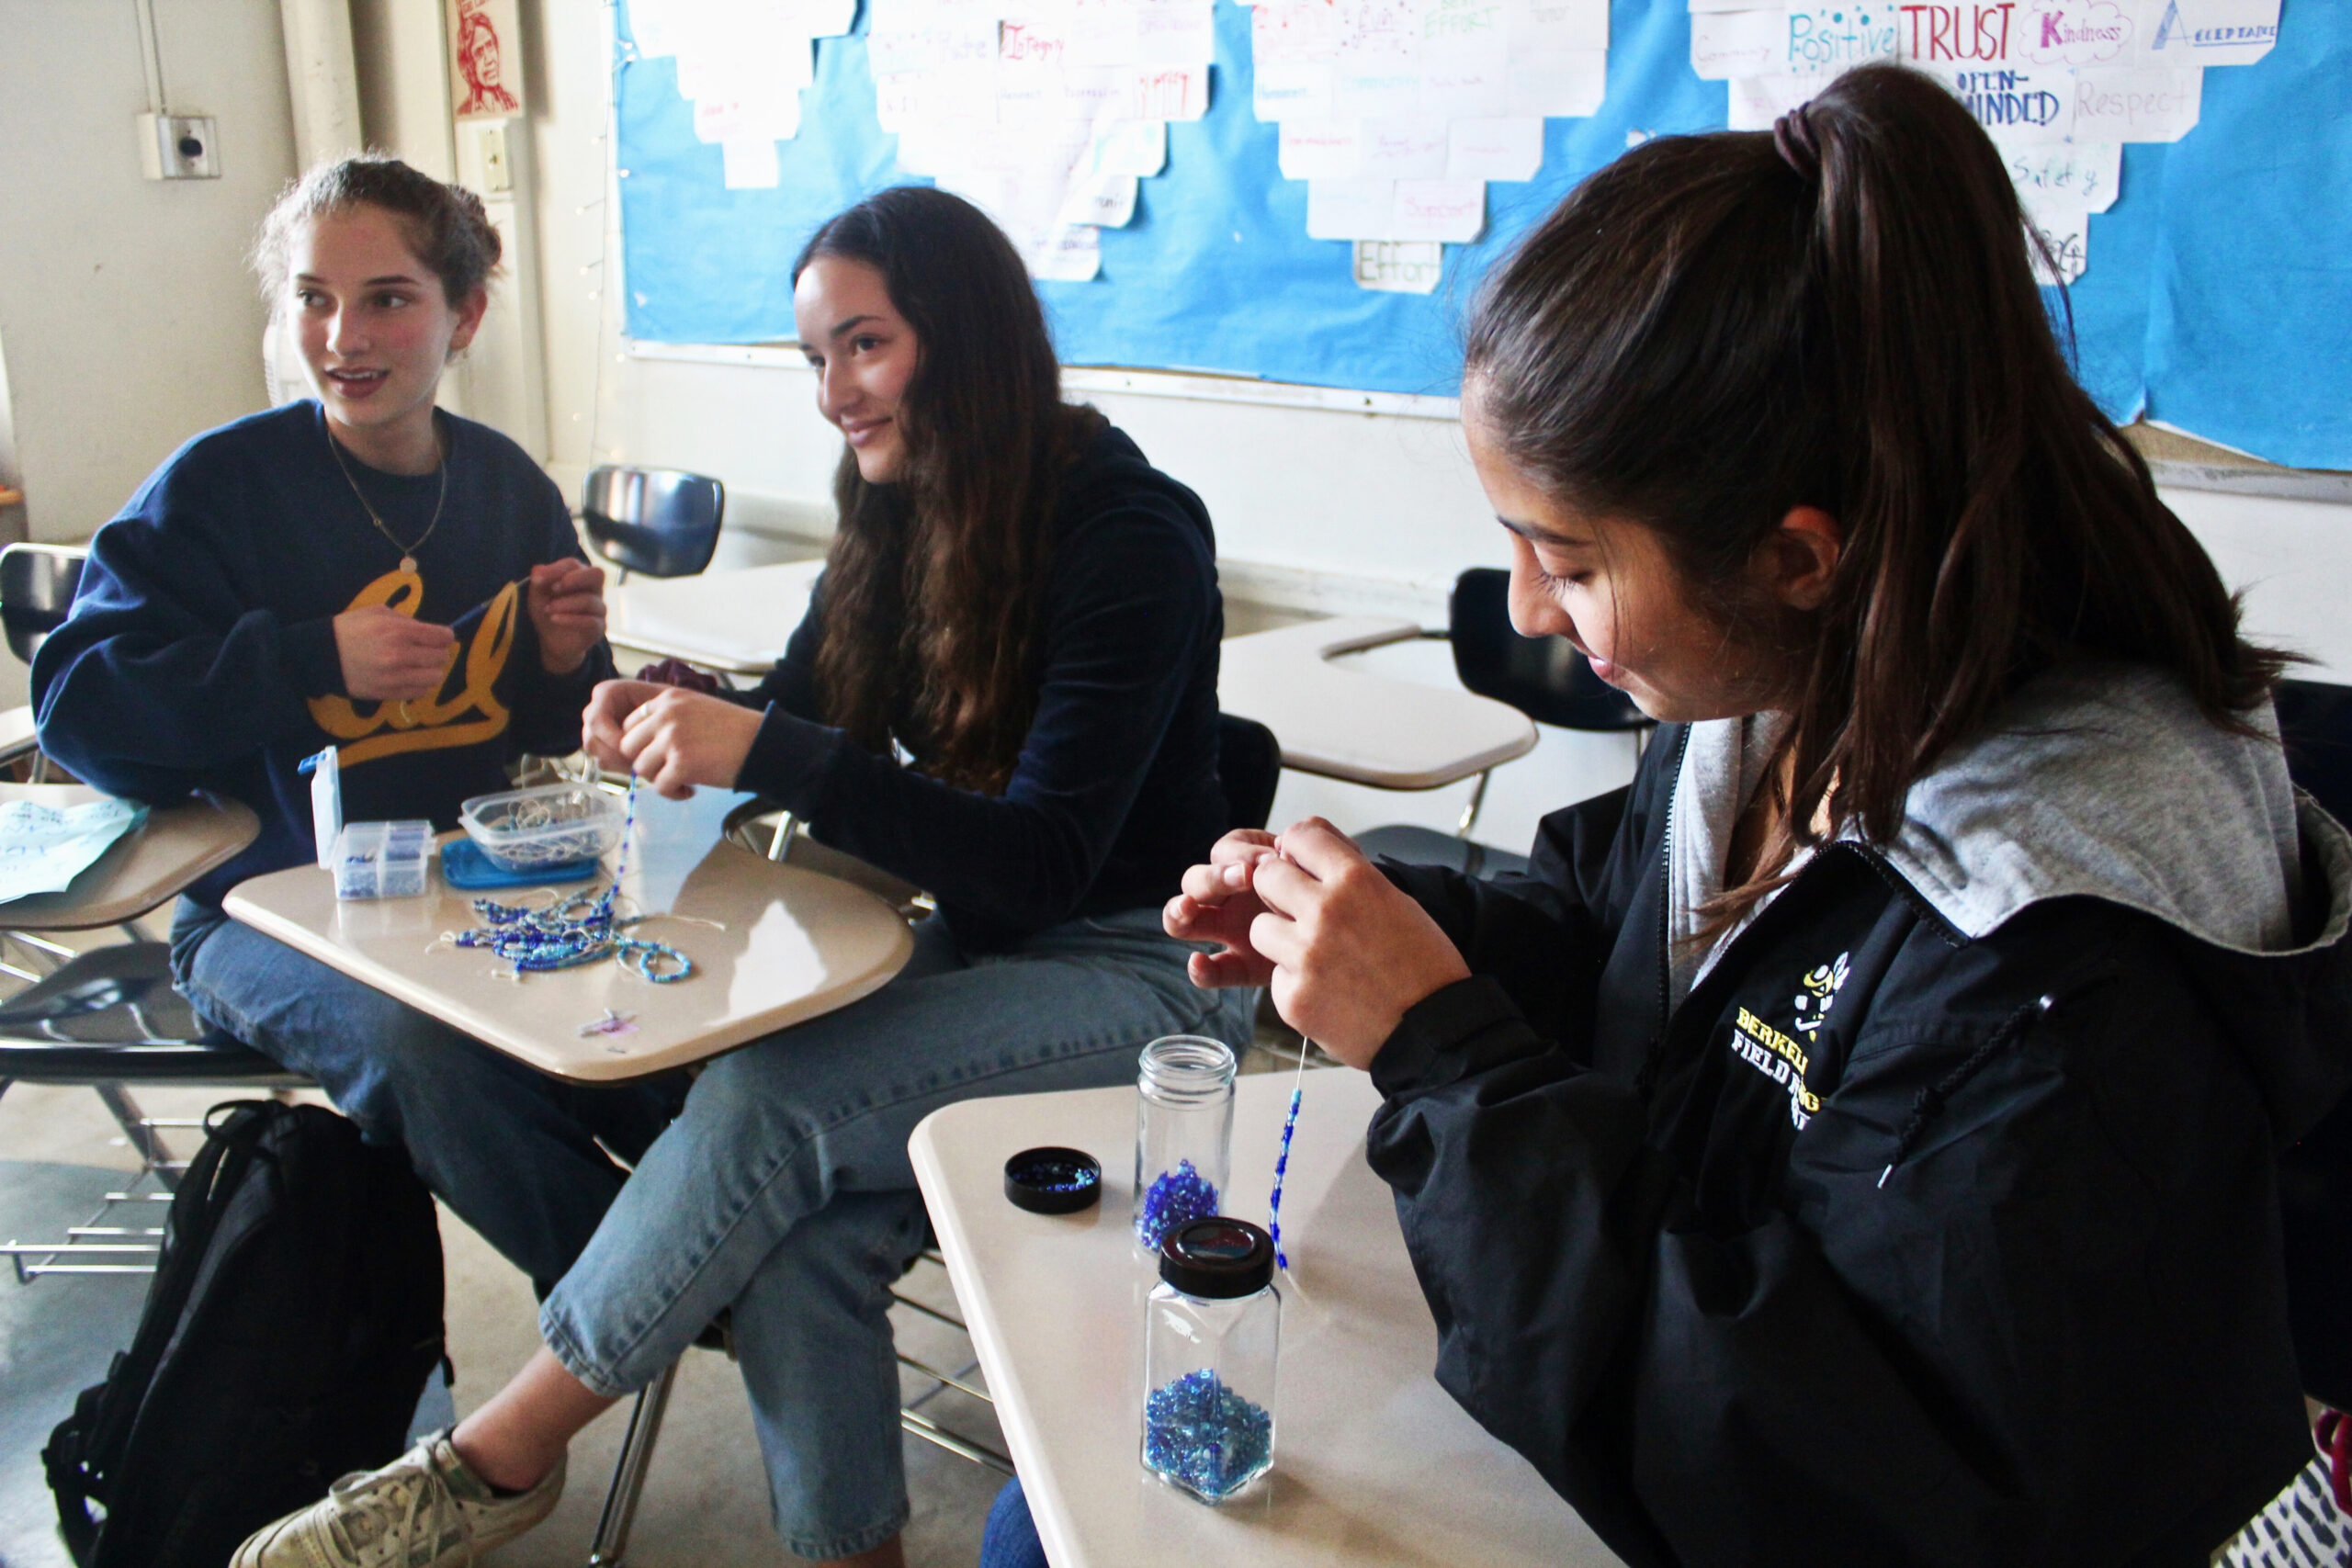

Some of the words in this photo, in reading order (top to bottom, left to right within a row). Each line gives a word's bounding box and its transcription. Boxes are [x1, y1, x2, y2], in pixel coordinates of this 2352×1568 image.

[1789, 13, 1894, 63] Positive
[1900, 3, 2015, 62] TRUST
[2041, 10, 2121, 49] Kindness
[1957, 70, 2029, 93] OPEN-
[2077, 80, 2188, 125] Respect
[2013, 154, 2098, 197] Safety
[1731, 1028, 1791, 1084] FIELD
